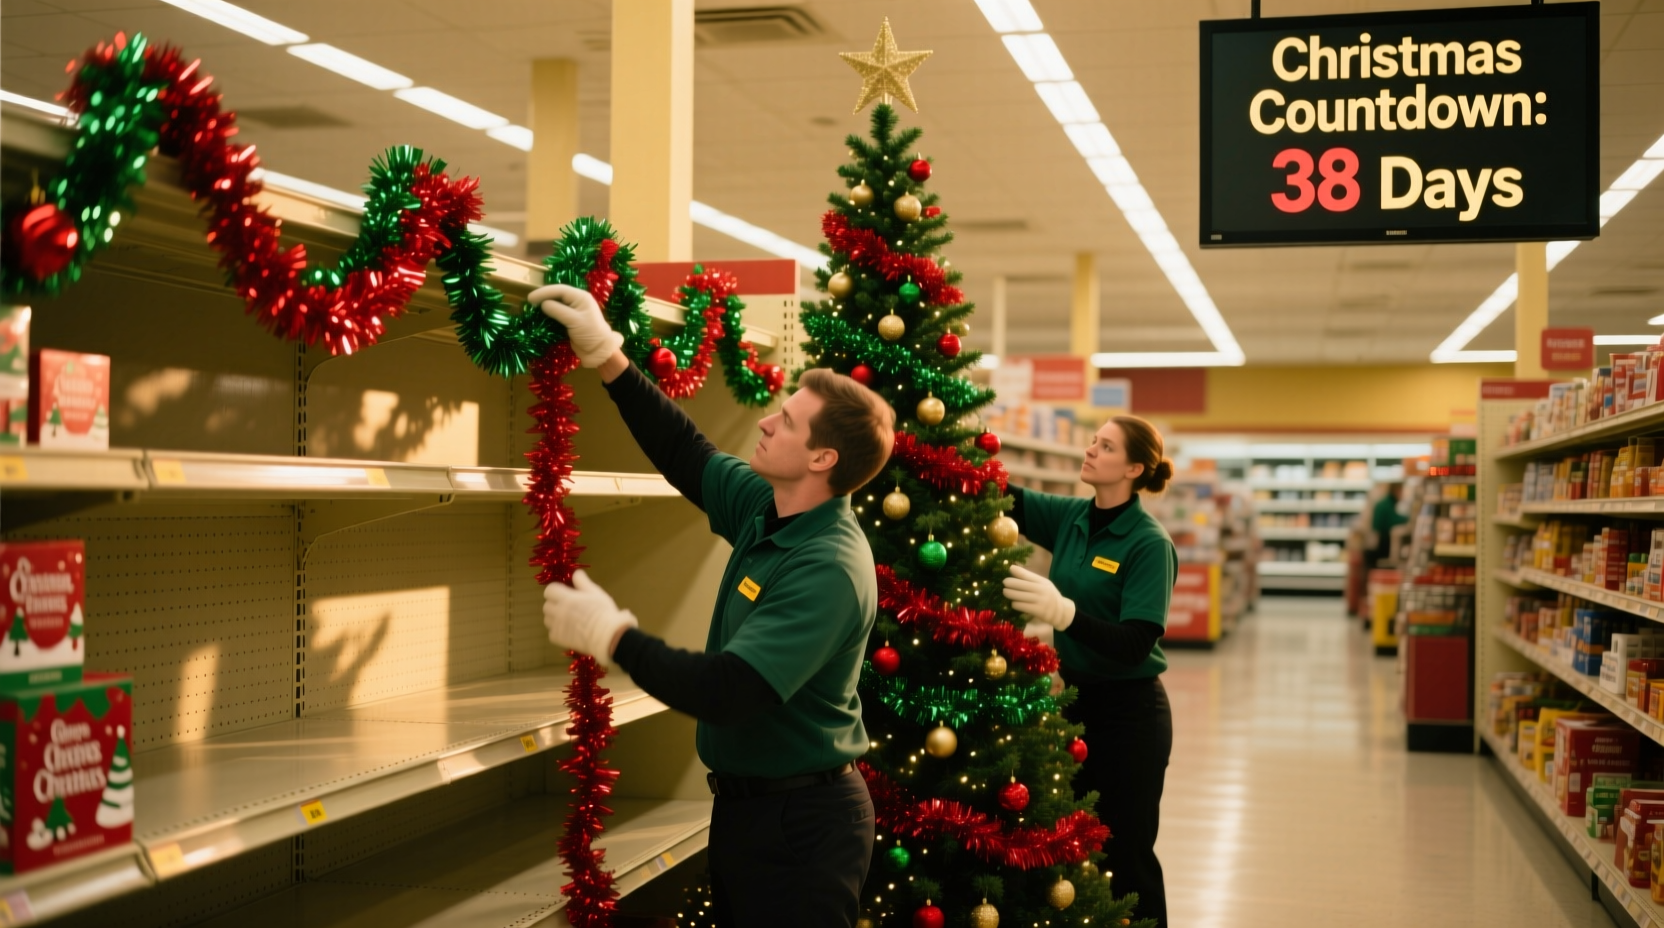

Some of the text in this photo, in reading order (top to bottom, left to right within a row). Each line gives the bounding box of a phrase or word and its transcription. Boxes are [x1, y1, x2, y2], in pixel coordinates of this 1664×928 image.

[1271, 32, 1522, 82] Christmas
[1249, 83, 1547, 135] Countdown:
[1270, 146, 1524, 222] 38 Days
